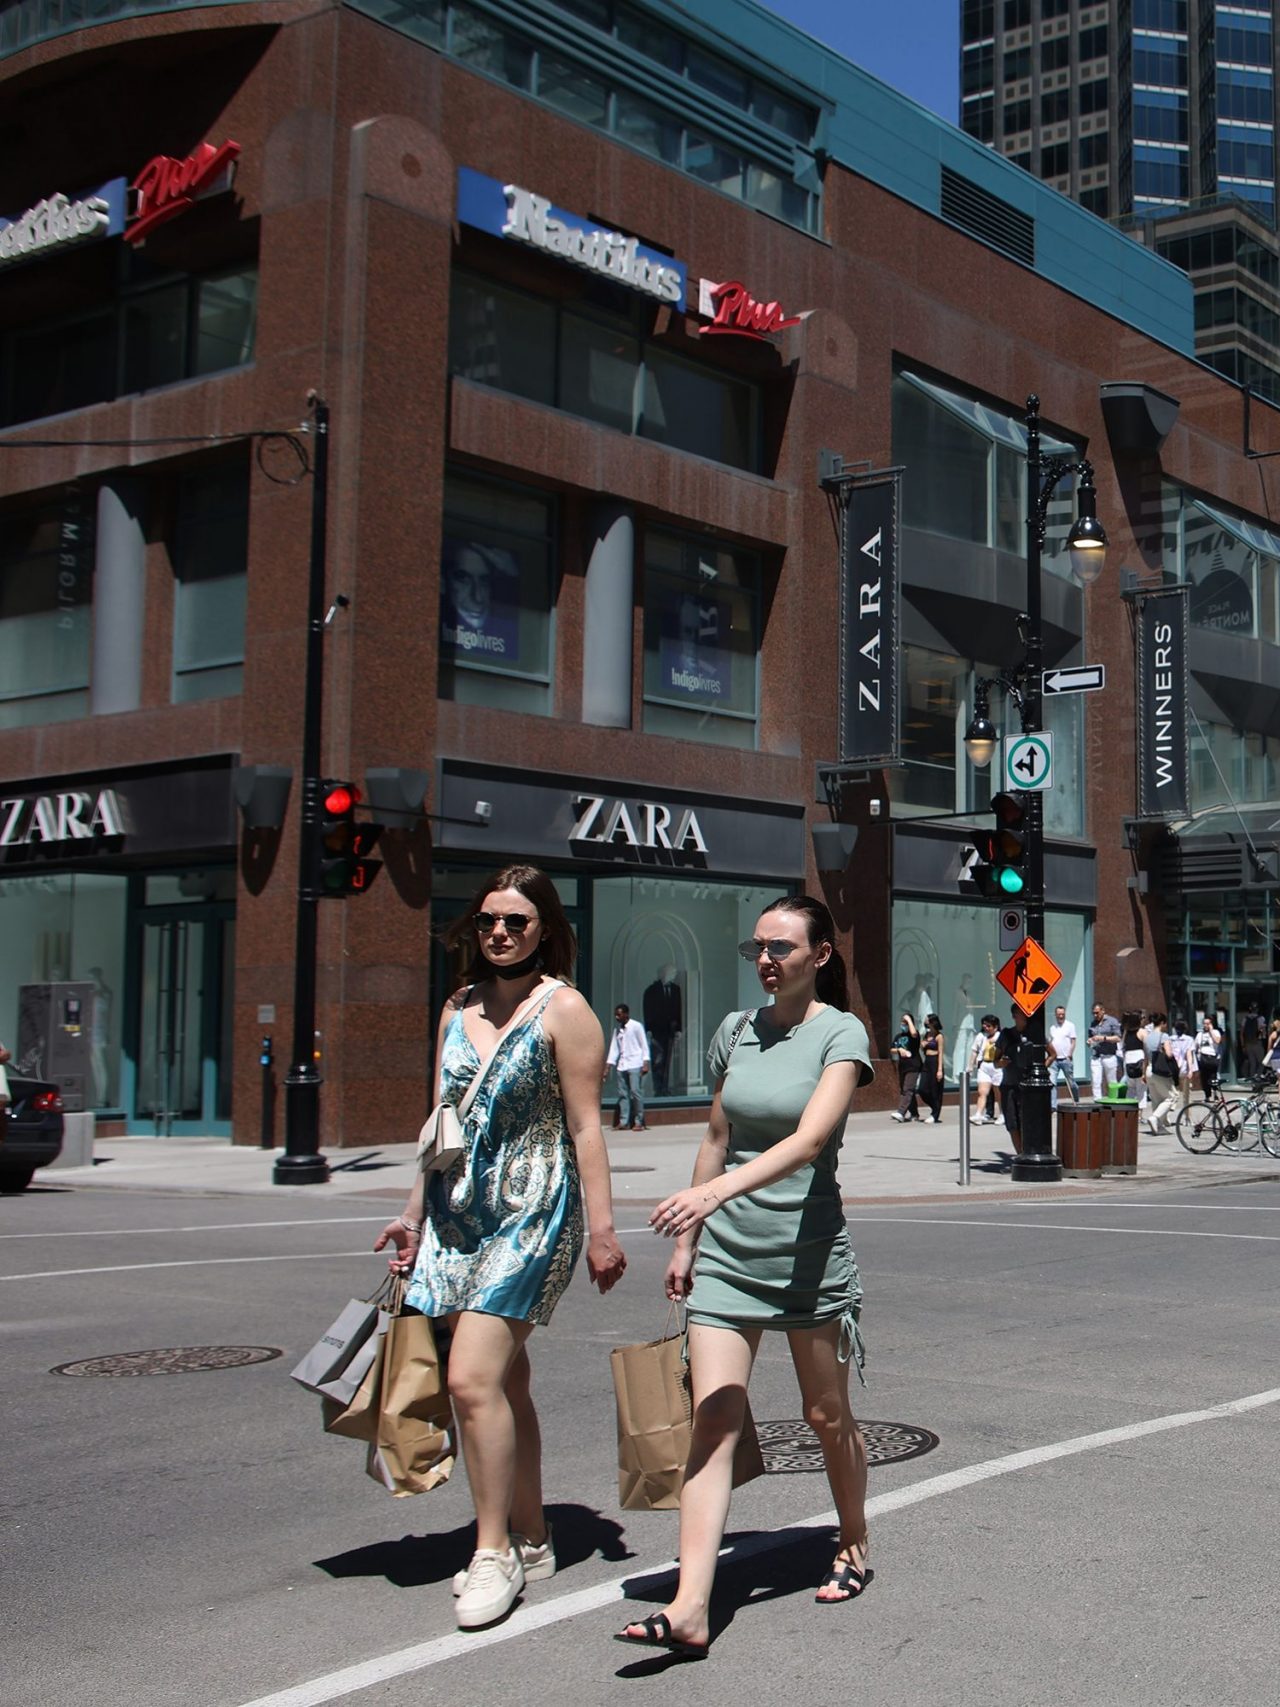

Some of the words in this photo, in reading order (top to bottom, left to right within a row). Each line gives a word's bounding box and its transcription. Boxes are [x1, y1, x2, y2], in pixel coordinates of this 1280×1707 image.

[502, 184, 684, 302] Nautilus
[700, 280, 808, 338] Plus
[858, 526, 882, 711] ZARA
[1155, 623, 1173, 789] WINNERS
[0, 789, 126, 846] ZARA
[569, 795, 709, 853] ZARA
